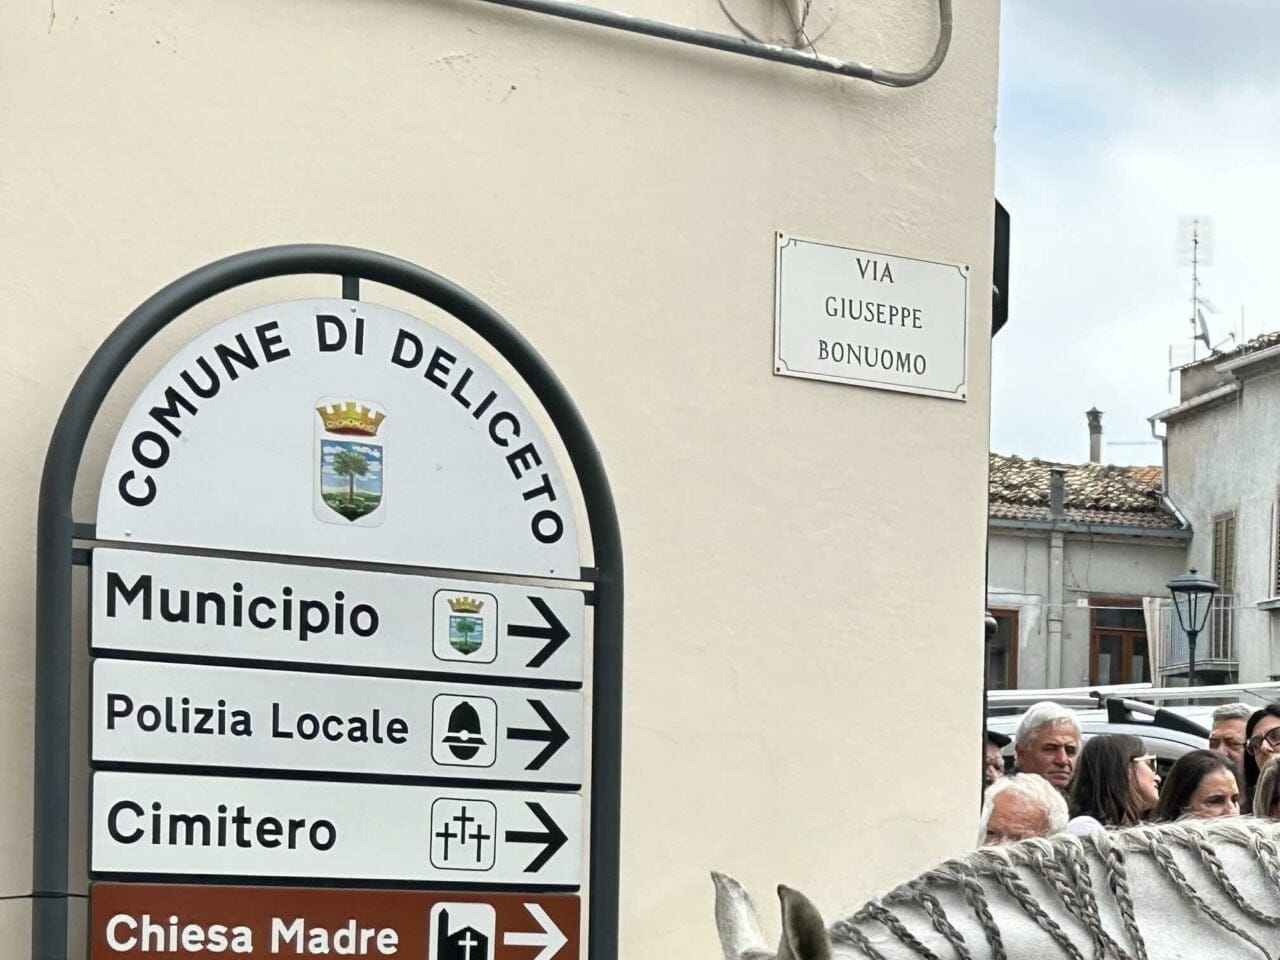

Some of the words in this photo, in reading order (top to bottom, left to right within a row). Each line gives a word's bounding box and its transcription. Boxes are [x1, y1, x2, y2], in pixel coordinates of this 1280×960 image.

[855, 257, 894, 284] VIA
[825, 296, 923, 329] GIUSEPPE
[817, 339, 927, 376] BONUOMO
[117, 320, 290, 508] COMUNE
[316, 314, 365, 355] DI
[391, 328, 564, 545] DELICETO
[106, 571, 379, 642] Municipio
[107, 693, 253, 737] Polizia
[271, 702, 409, 745] Locale
[107, 800, 337, 852] Cimitero
[106, 913, 254, 954] Chiesa
[271, 917, 399, 955] Madre
